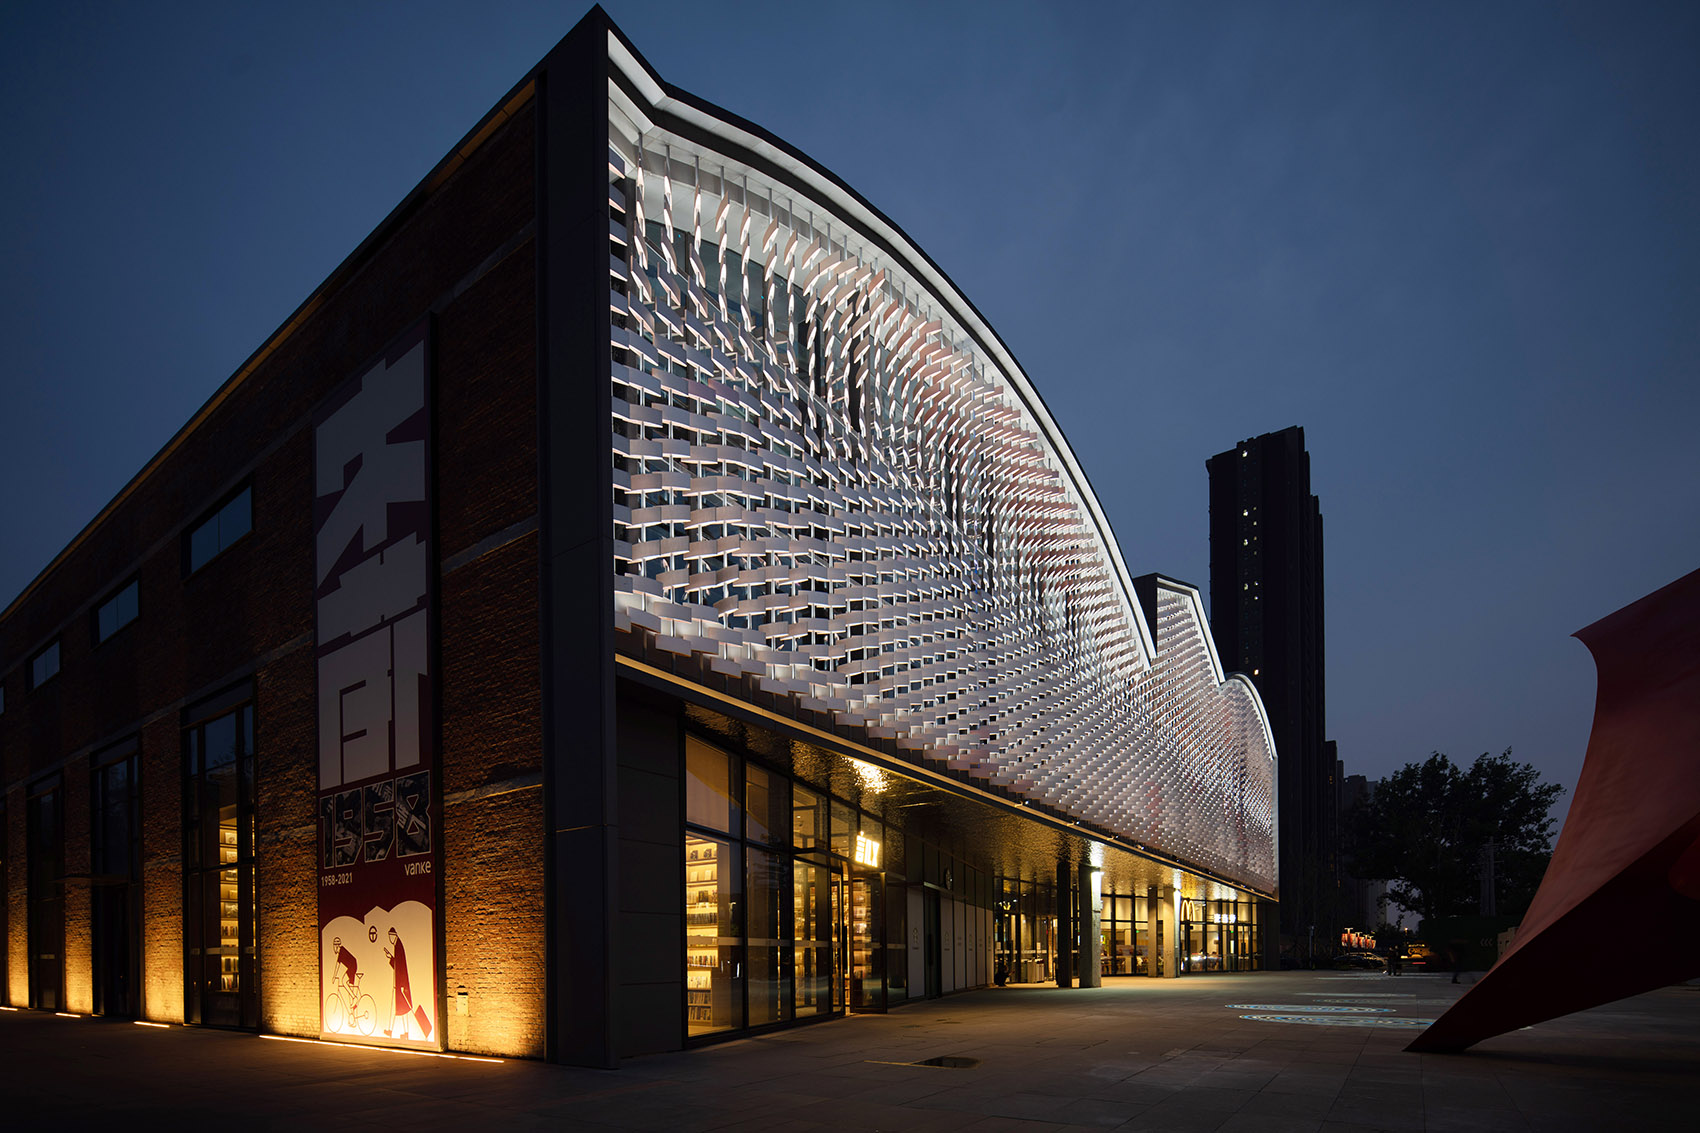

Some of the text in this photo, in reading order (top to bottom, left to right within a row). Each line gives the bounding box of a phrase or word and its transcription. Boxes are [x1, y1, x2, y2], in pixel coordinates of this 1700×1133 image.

[320, 769, 432, 870] 1958
[404, 861, 432, 876] vanke
[321, 872, 353, 887] 1958-2021
